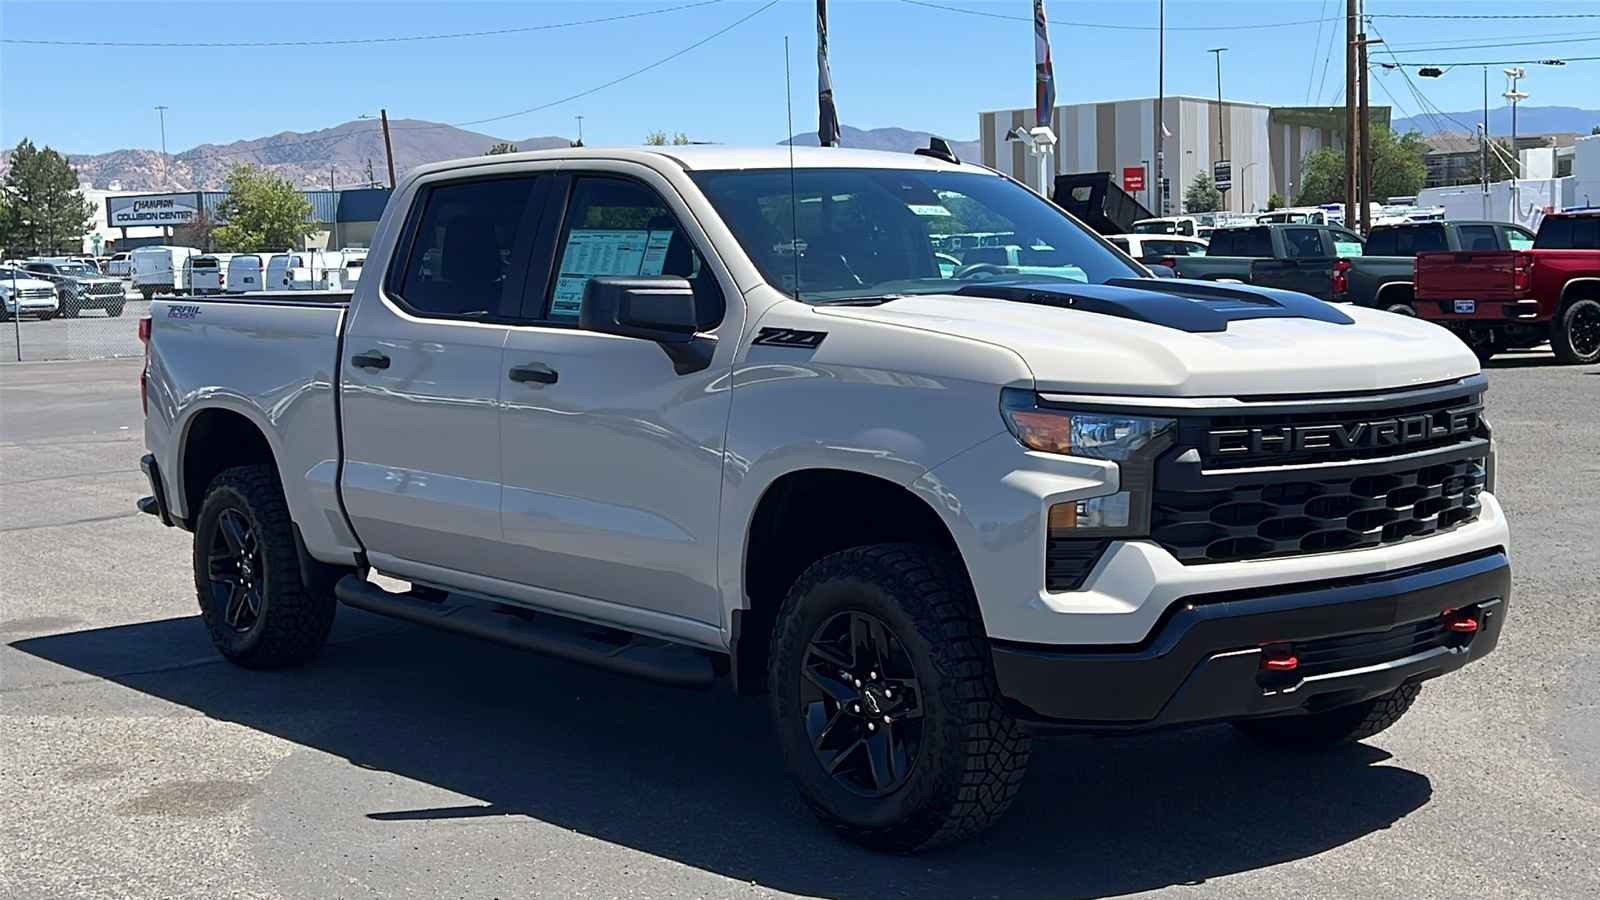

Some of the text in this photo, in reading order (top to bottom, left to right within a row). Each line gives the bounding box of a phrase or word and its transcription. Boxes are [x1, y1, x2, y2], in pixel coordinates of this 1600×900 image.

[133, 199, 174, 212] CHAMPION
[117, 211, 193, 221] COLLISION CENTER
[167, 305, 202, 314] TRAIL
